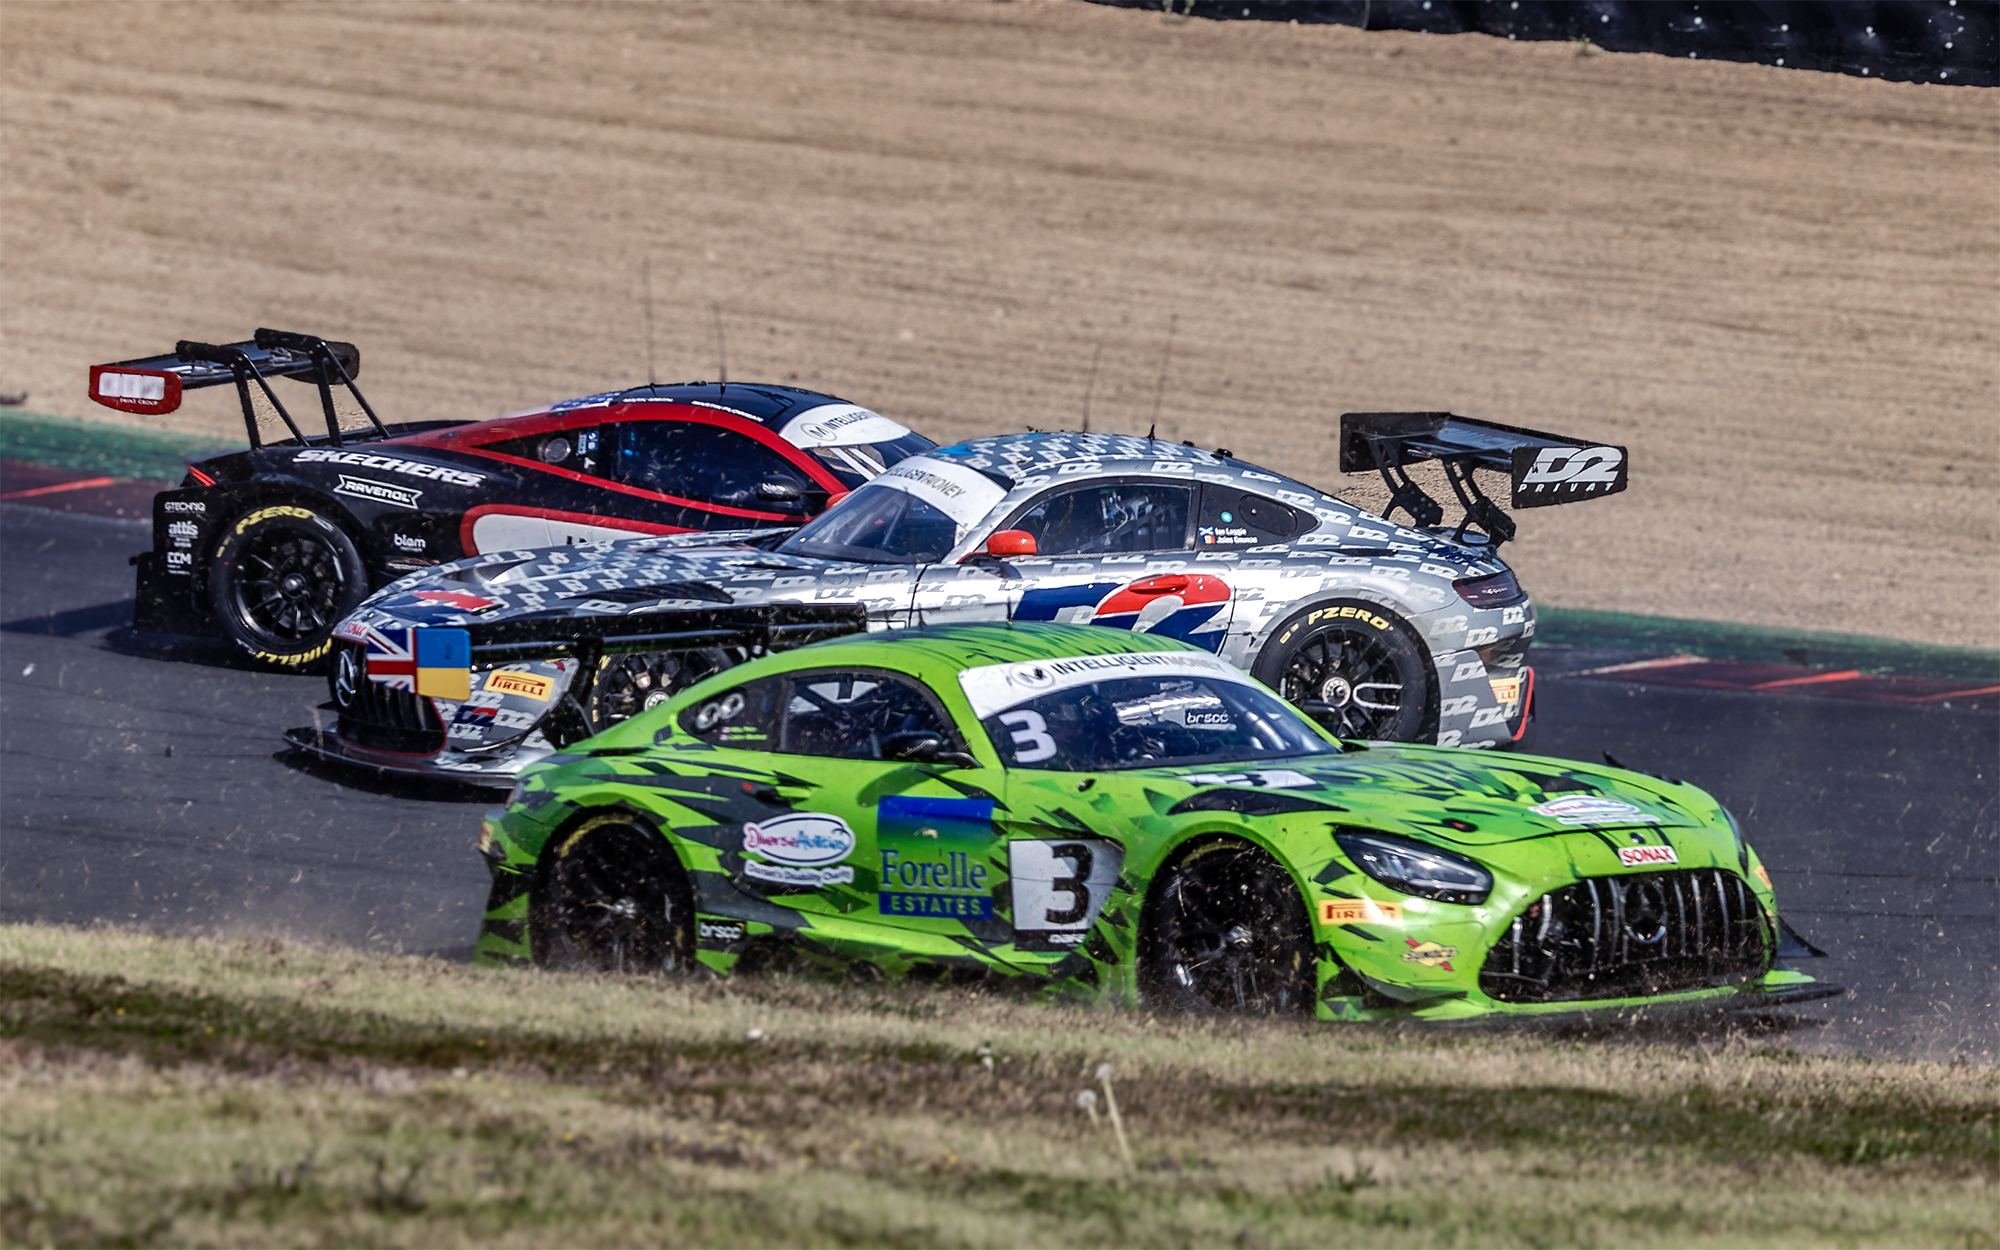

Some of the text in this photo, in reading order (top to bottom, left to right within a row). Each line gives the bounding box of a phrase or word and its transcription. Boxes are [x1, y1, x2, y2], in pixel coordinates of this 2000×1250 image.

[292, 449, 487, 488] SKECHERS
[1058, 463, 1102, 474] D2
[1151, 461, 1194, 473] D2
[1523, 446, 1623, 483] D2
[346, 480, 411, 503] RAVENOL
[1275, 489, 1315, 506] D2
[1517, 483, 1615, 493] PRIVAT
[1297, 534, 1341, 545] D2
[1347, 525, 1390, 541] D2
[1307, 606, 1390, 631] PZERO
[1502, 606, 1525, 625] D2
[1464, 627, 1499, 647] D2
[490, 675, 547, 697] PIRELLI
[452, 705, 498, 728] D2
[497, 708, 537, 730] D2
[998, 708, 1058, 764] 3
[1621, 848, 1674, 864] SONAX
[879, 848, 989, 893] Forelle
[1045, 843, 1092, 924] 3
[890, 895, 981, 916] ESTATES
